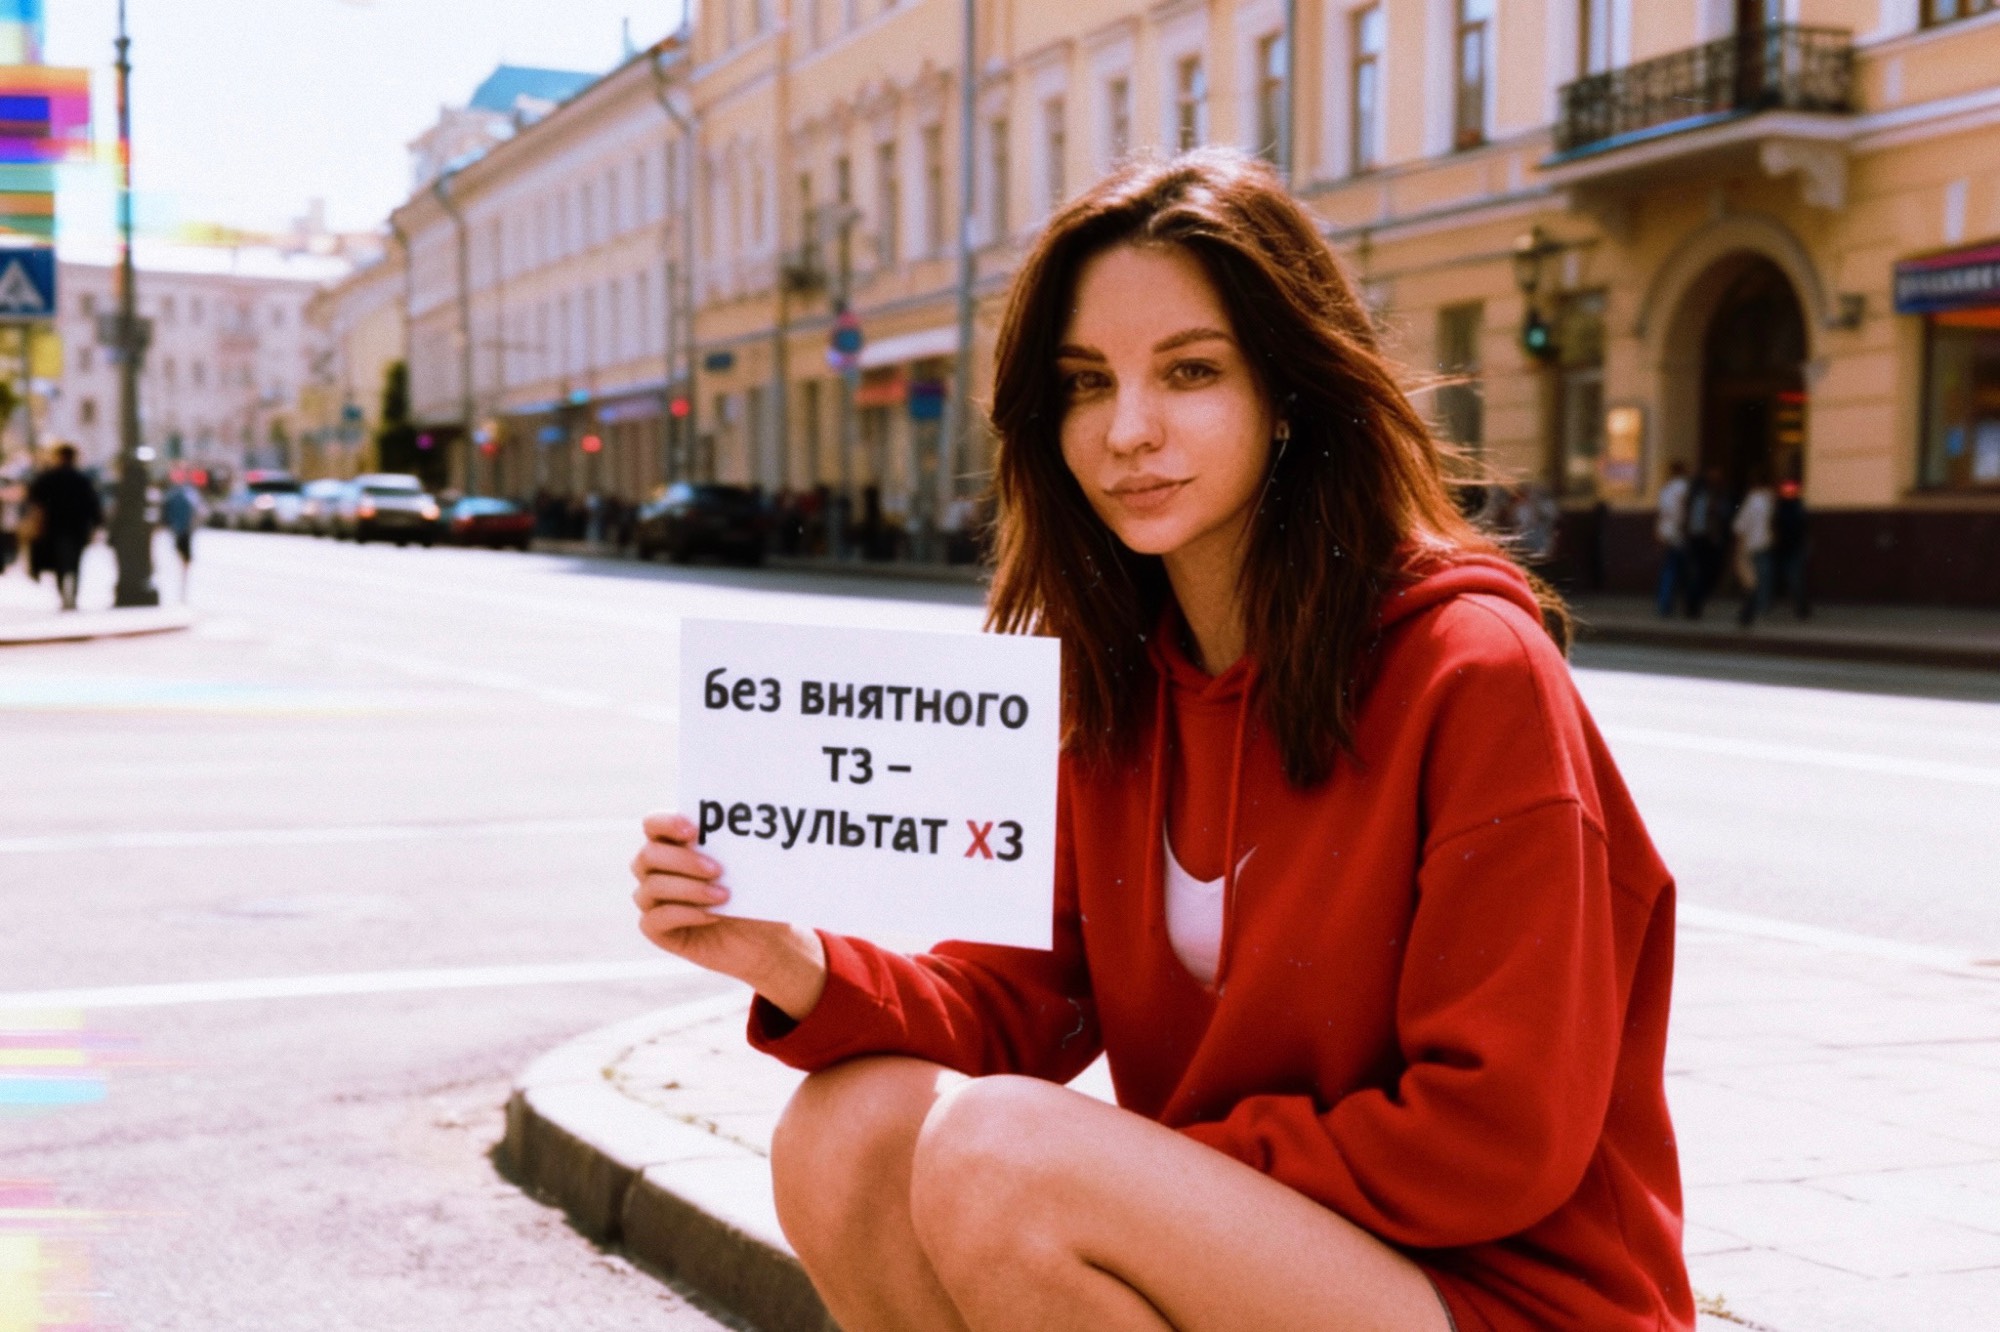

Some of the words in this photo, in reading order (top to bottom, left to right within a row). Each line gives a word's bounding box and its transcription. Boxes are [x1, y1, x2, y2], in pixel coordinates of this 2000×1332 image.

[704, 667, 782, 713] без
[800, 680, 1029, 730] внятного
[697, 799, 949, 855] результат
